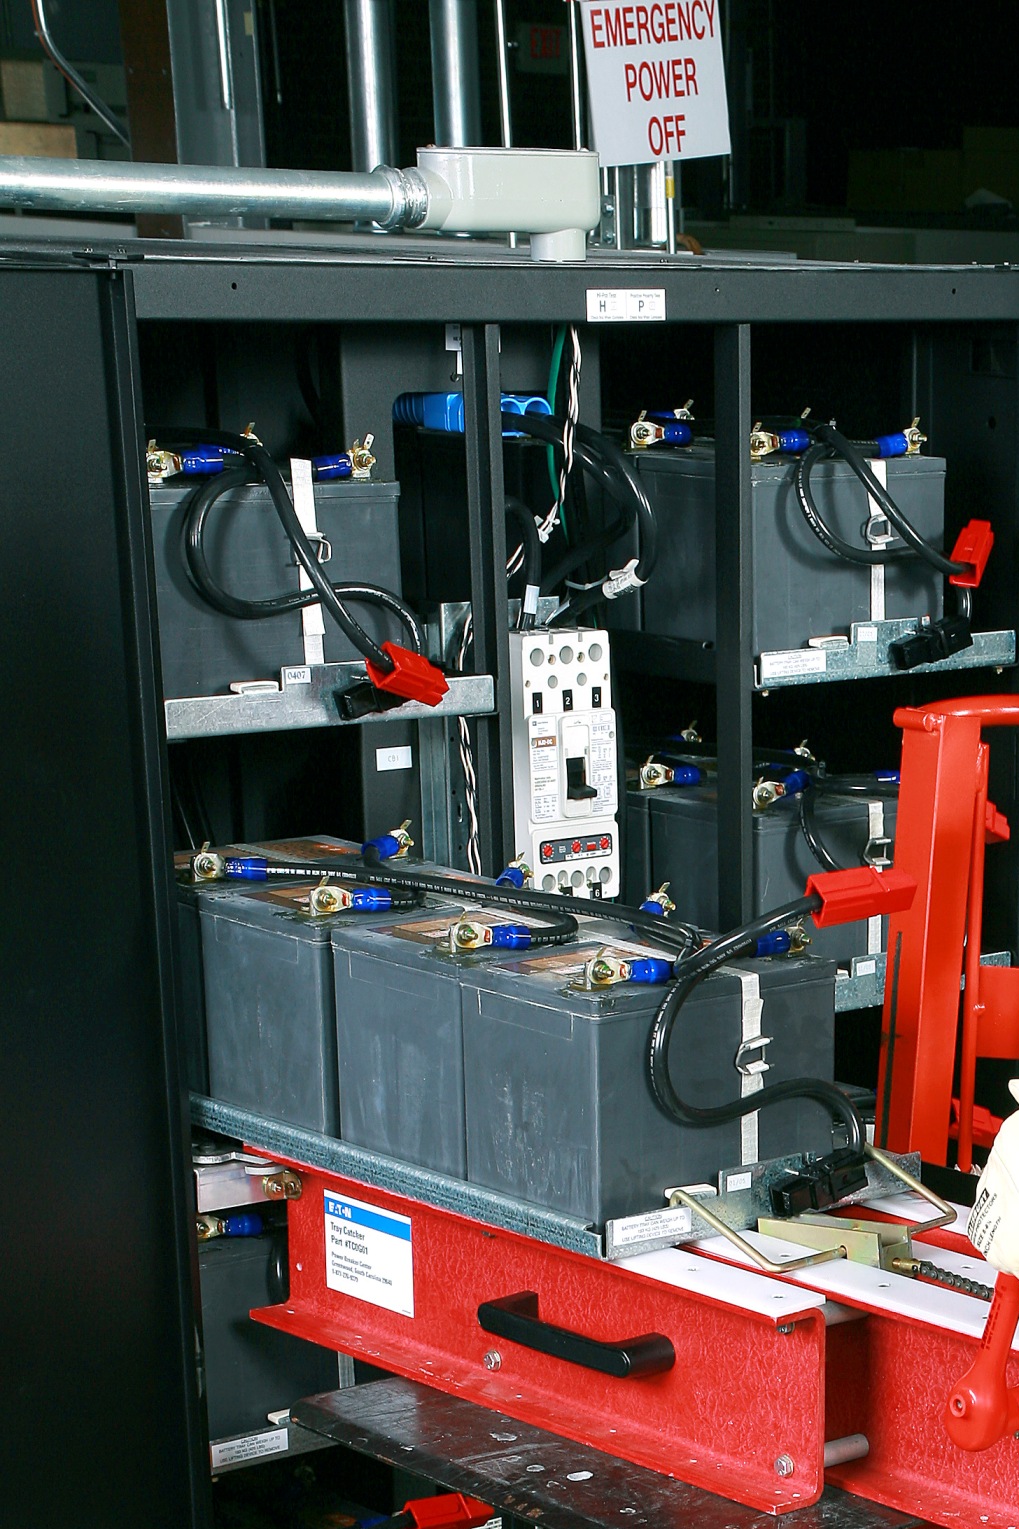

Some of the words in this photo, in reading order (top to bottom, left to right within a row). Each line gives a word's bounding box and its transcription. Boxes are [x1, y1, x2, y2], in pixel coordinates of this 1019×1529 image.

[590, 0, 715, 48] EMERGENCY
[530, 28, 561, 58] EXIT
[625, 58, 698, 102] POWER
[648, 115, 686, 155] OFF
[600, 300, 606, 312] H
[639, 300, 644, 312] P
[288, 671, 306, 680] 0407
[594, 694, 599, 702] 3
[595, 889, 600, 897] 6
[329, 1201, 352, 1219] EATON
[331, 1222, 342, 1235] Tray
[343, 1226, 365, 1241] Catcher
[331, 1235, 343, 1246] Part
